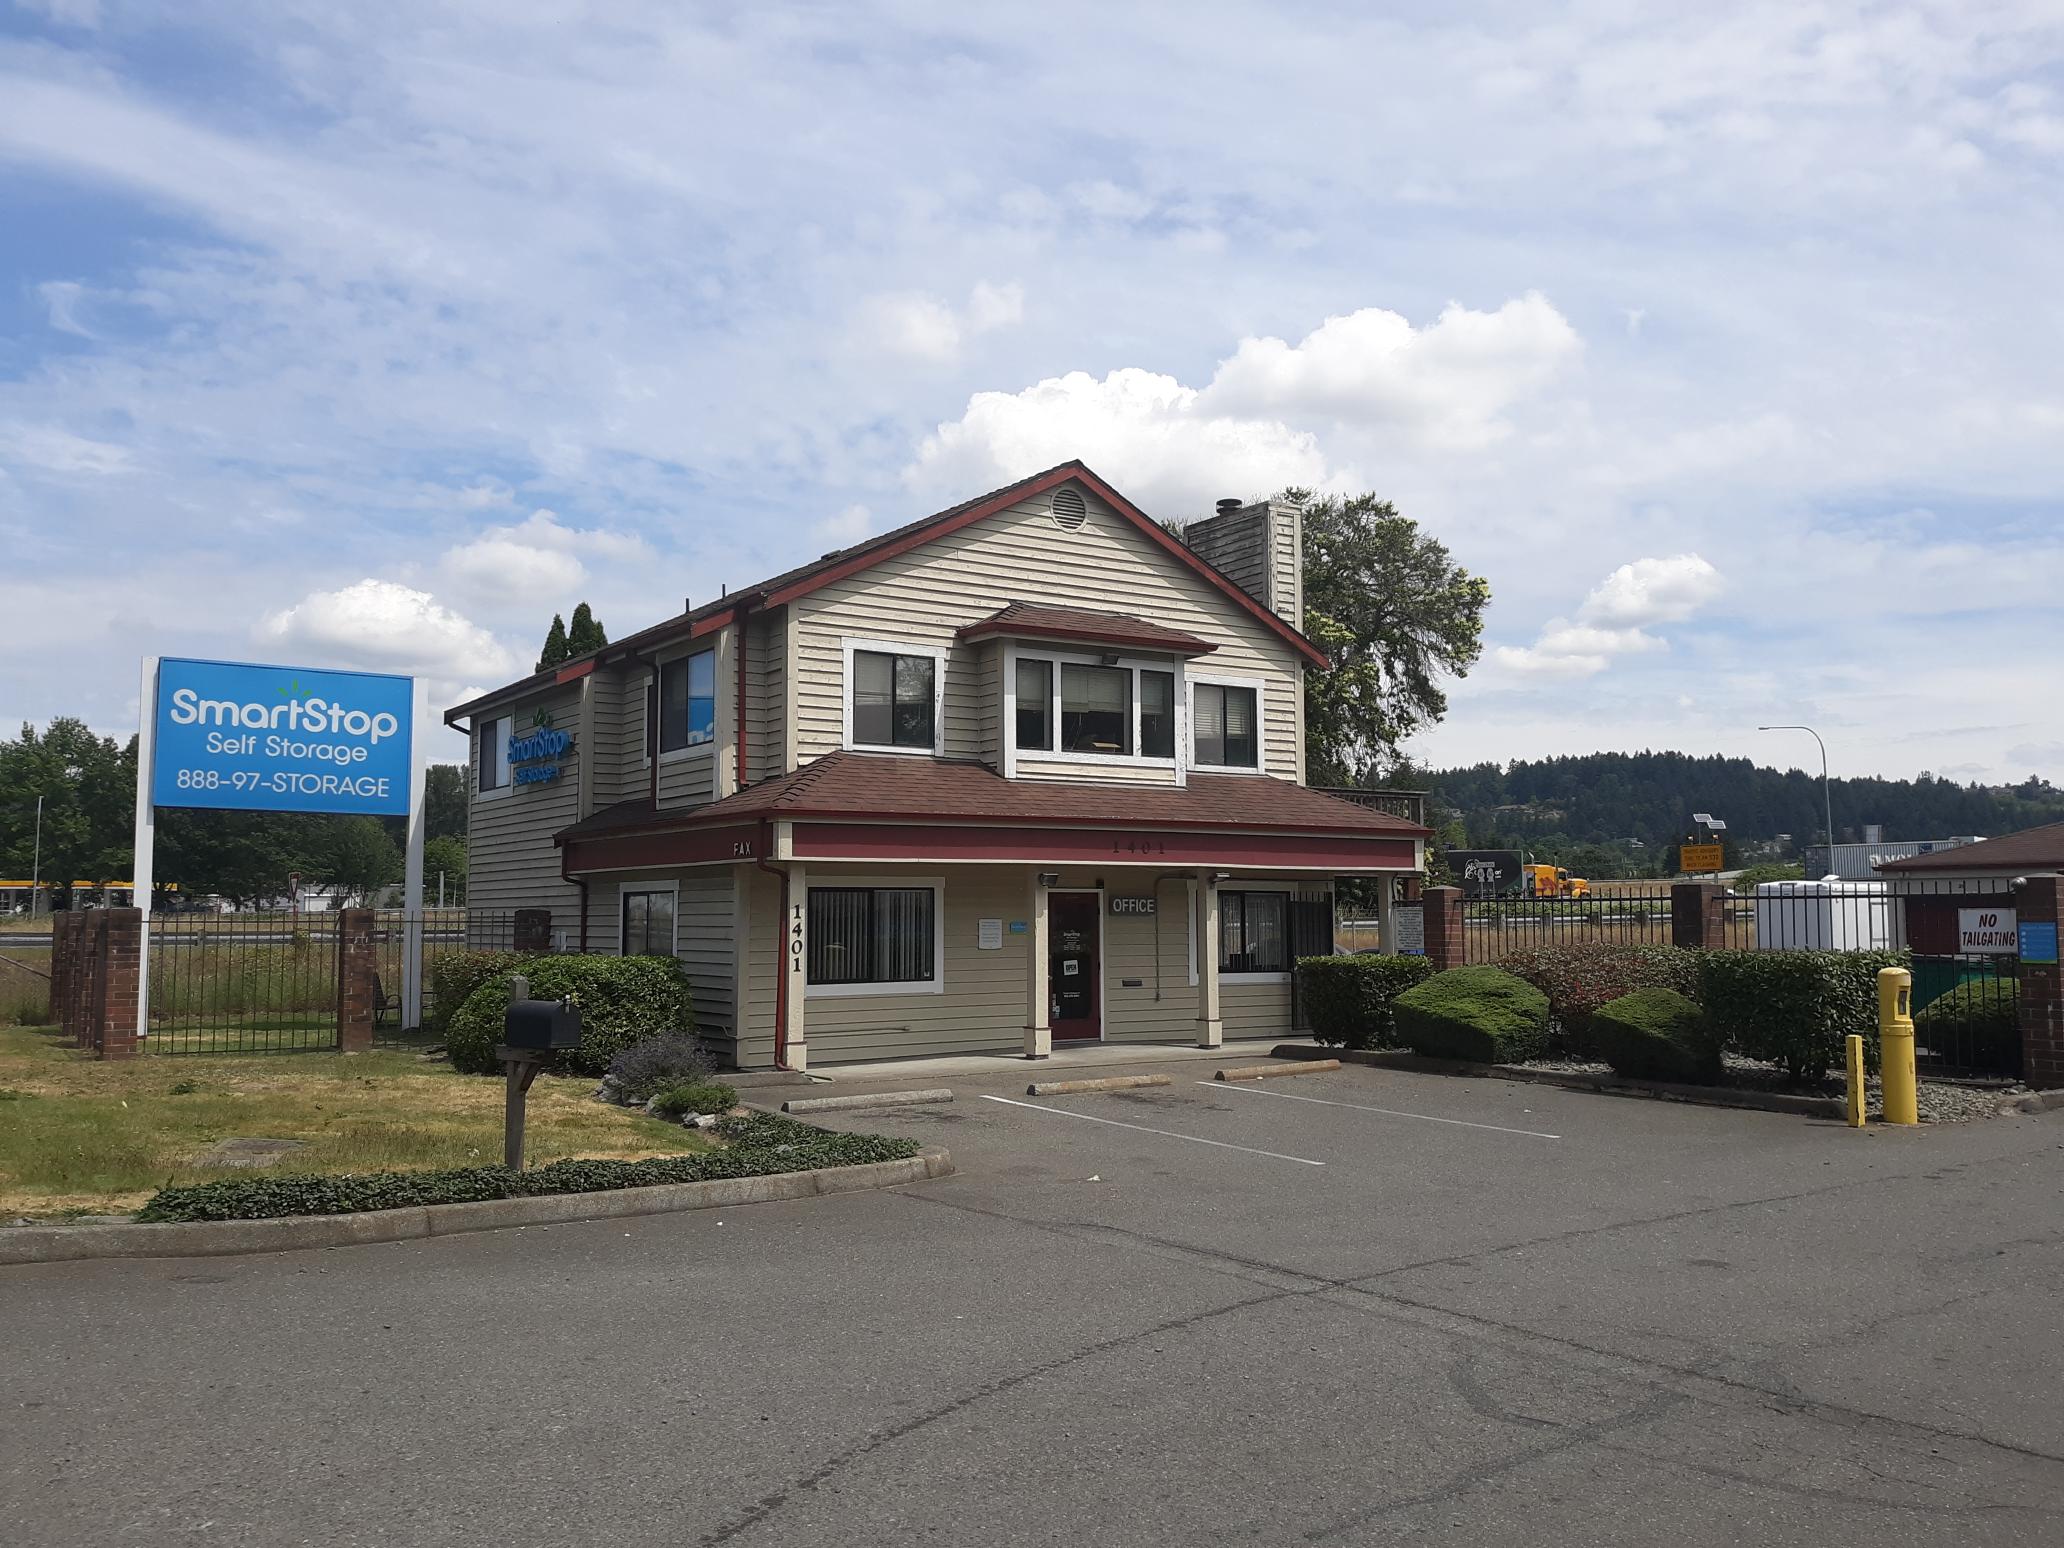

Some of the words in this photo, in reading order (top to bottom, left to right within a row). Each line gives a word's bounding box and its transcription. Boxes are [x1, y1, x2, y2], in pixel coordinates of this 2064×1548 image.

[171, 688, 398, 745] SmartStop
[206, 731, 256, 755] Self
[265, 735, 368, 766] Storage
[507, 727, 569, 764] SmartStop
[177, 769, 390, 798] 888-97-STORAGE
[733, 841, 751, 856] FAX
[1113, 841, 1165, 855] 1401
[1113, 898, 1155, 913] OFFICE
[1978, 913, 1997, 928] NO
[791, 904, 803, 972] 1401
[1962, 931, 2016, 947] TAILGATING
